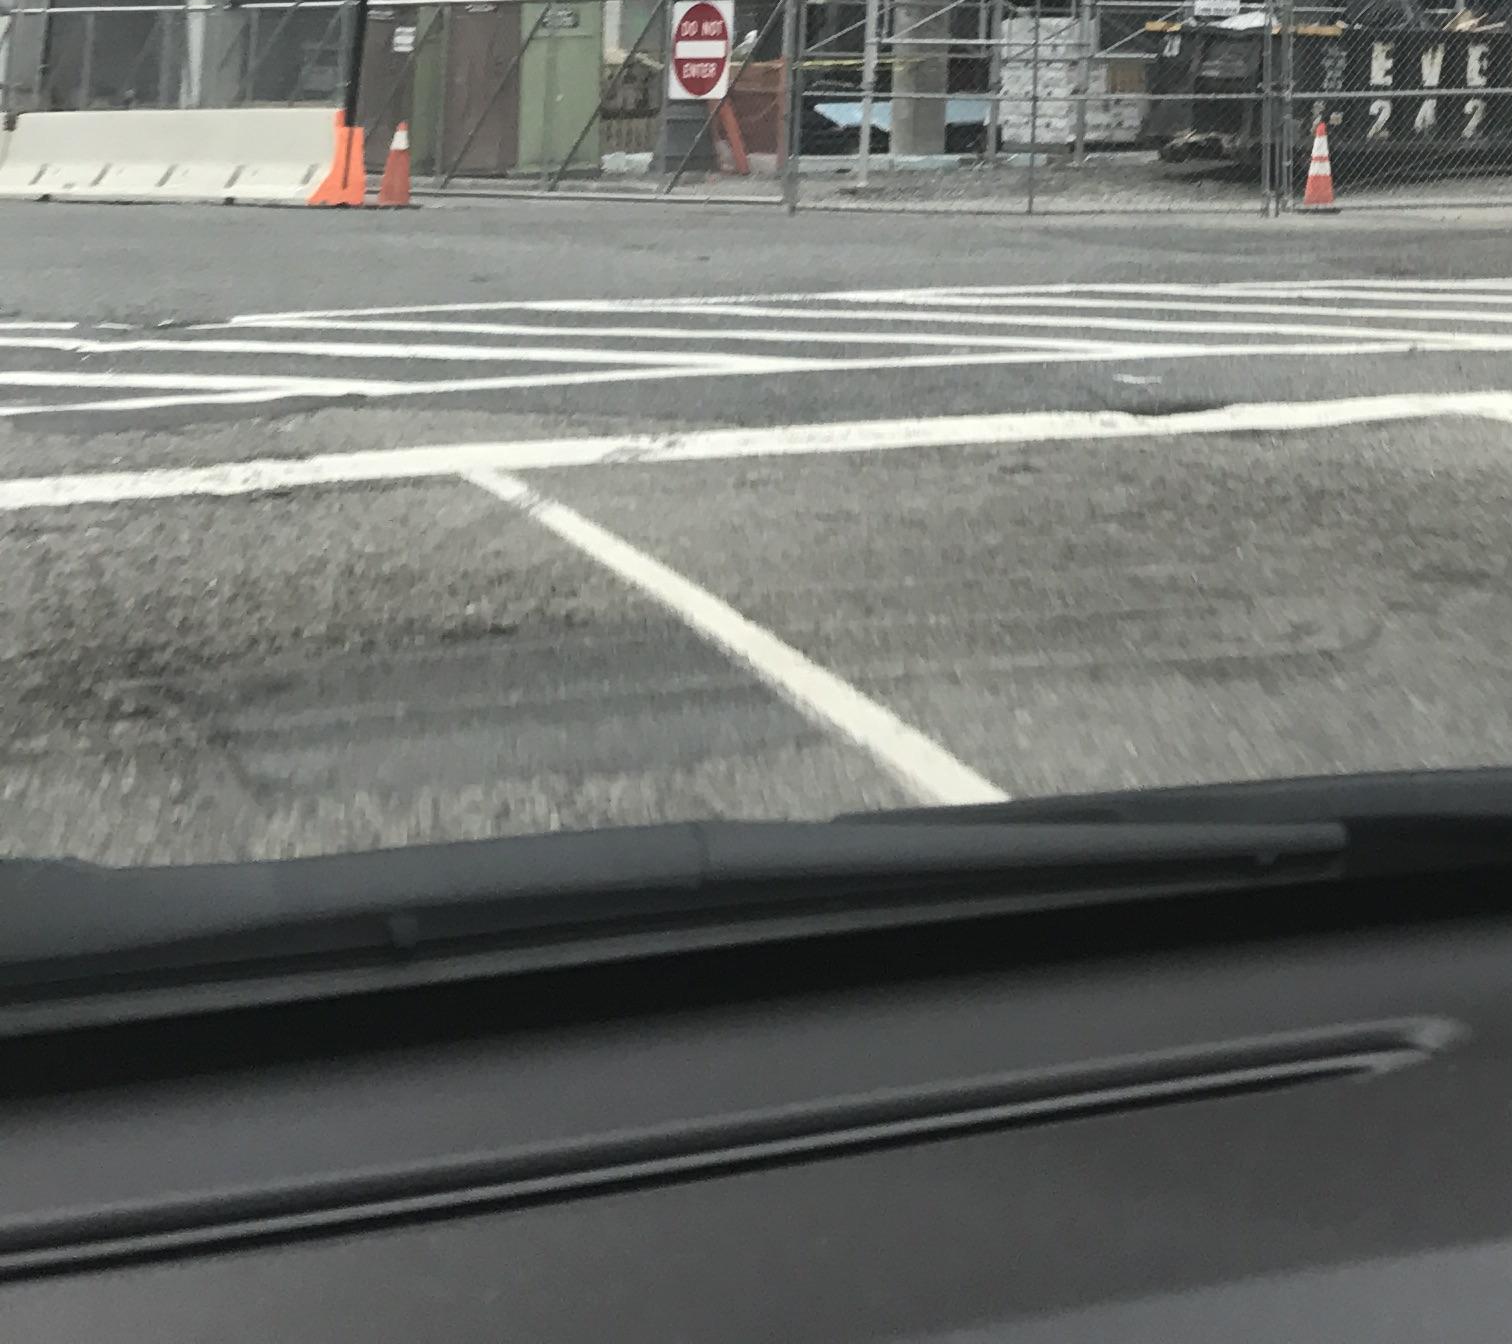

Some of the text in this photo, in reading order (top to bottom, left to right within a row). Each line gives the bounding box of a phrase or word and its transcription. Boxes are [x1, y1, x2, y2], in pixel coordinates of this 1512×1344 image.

[681, 20, 723, 37] DO NOT
[682, 62, 717, 79] ENTER
